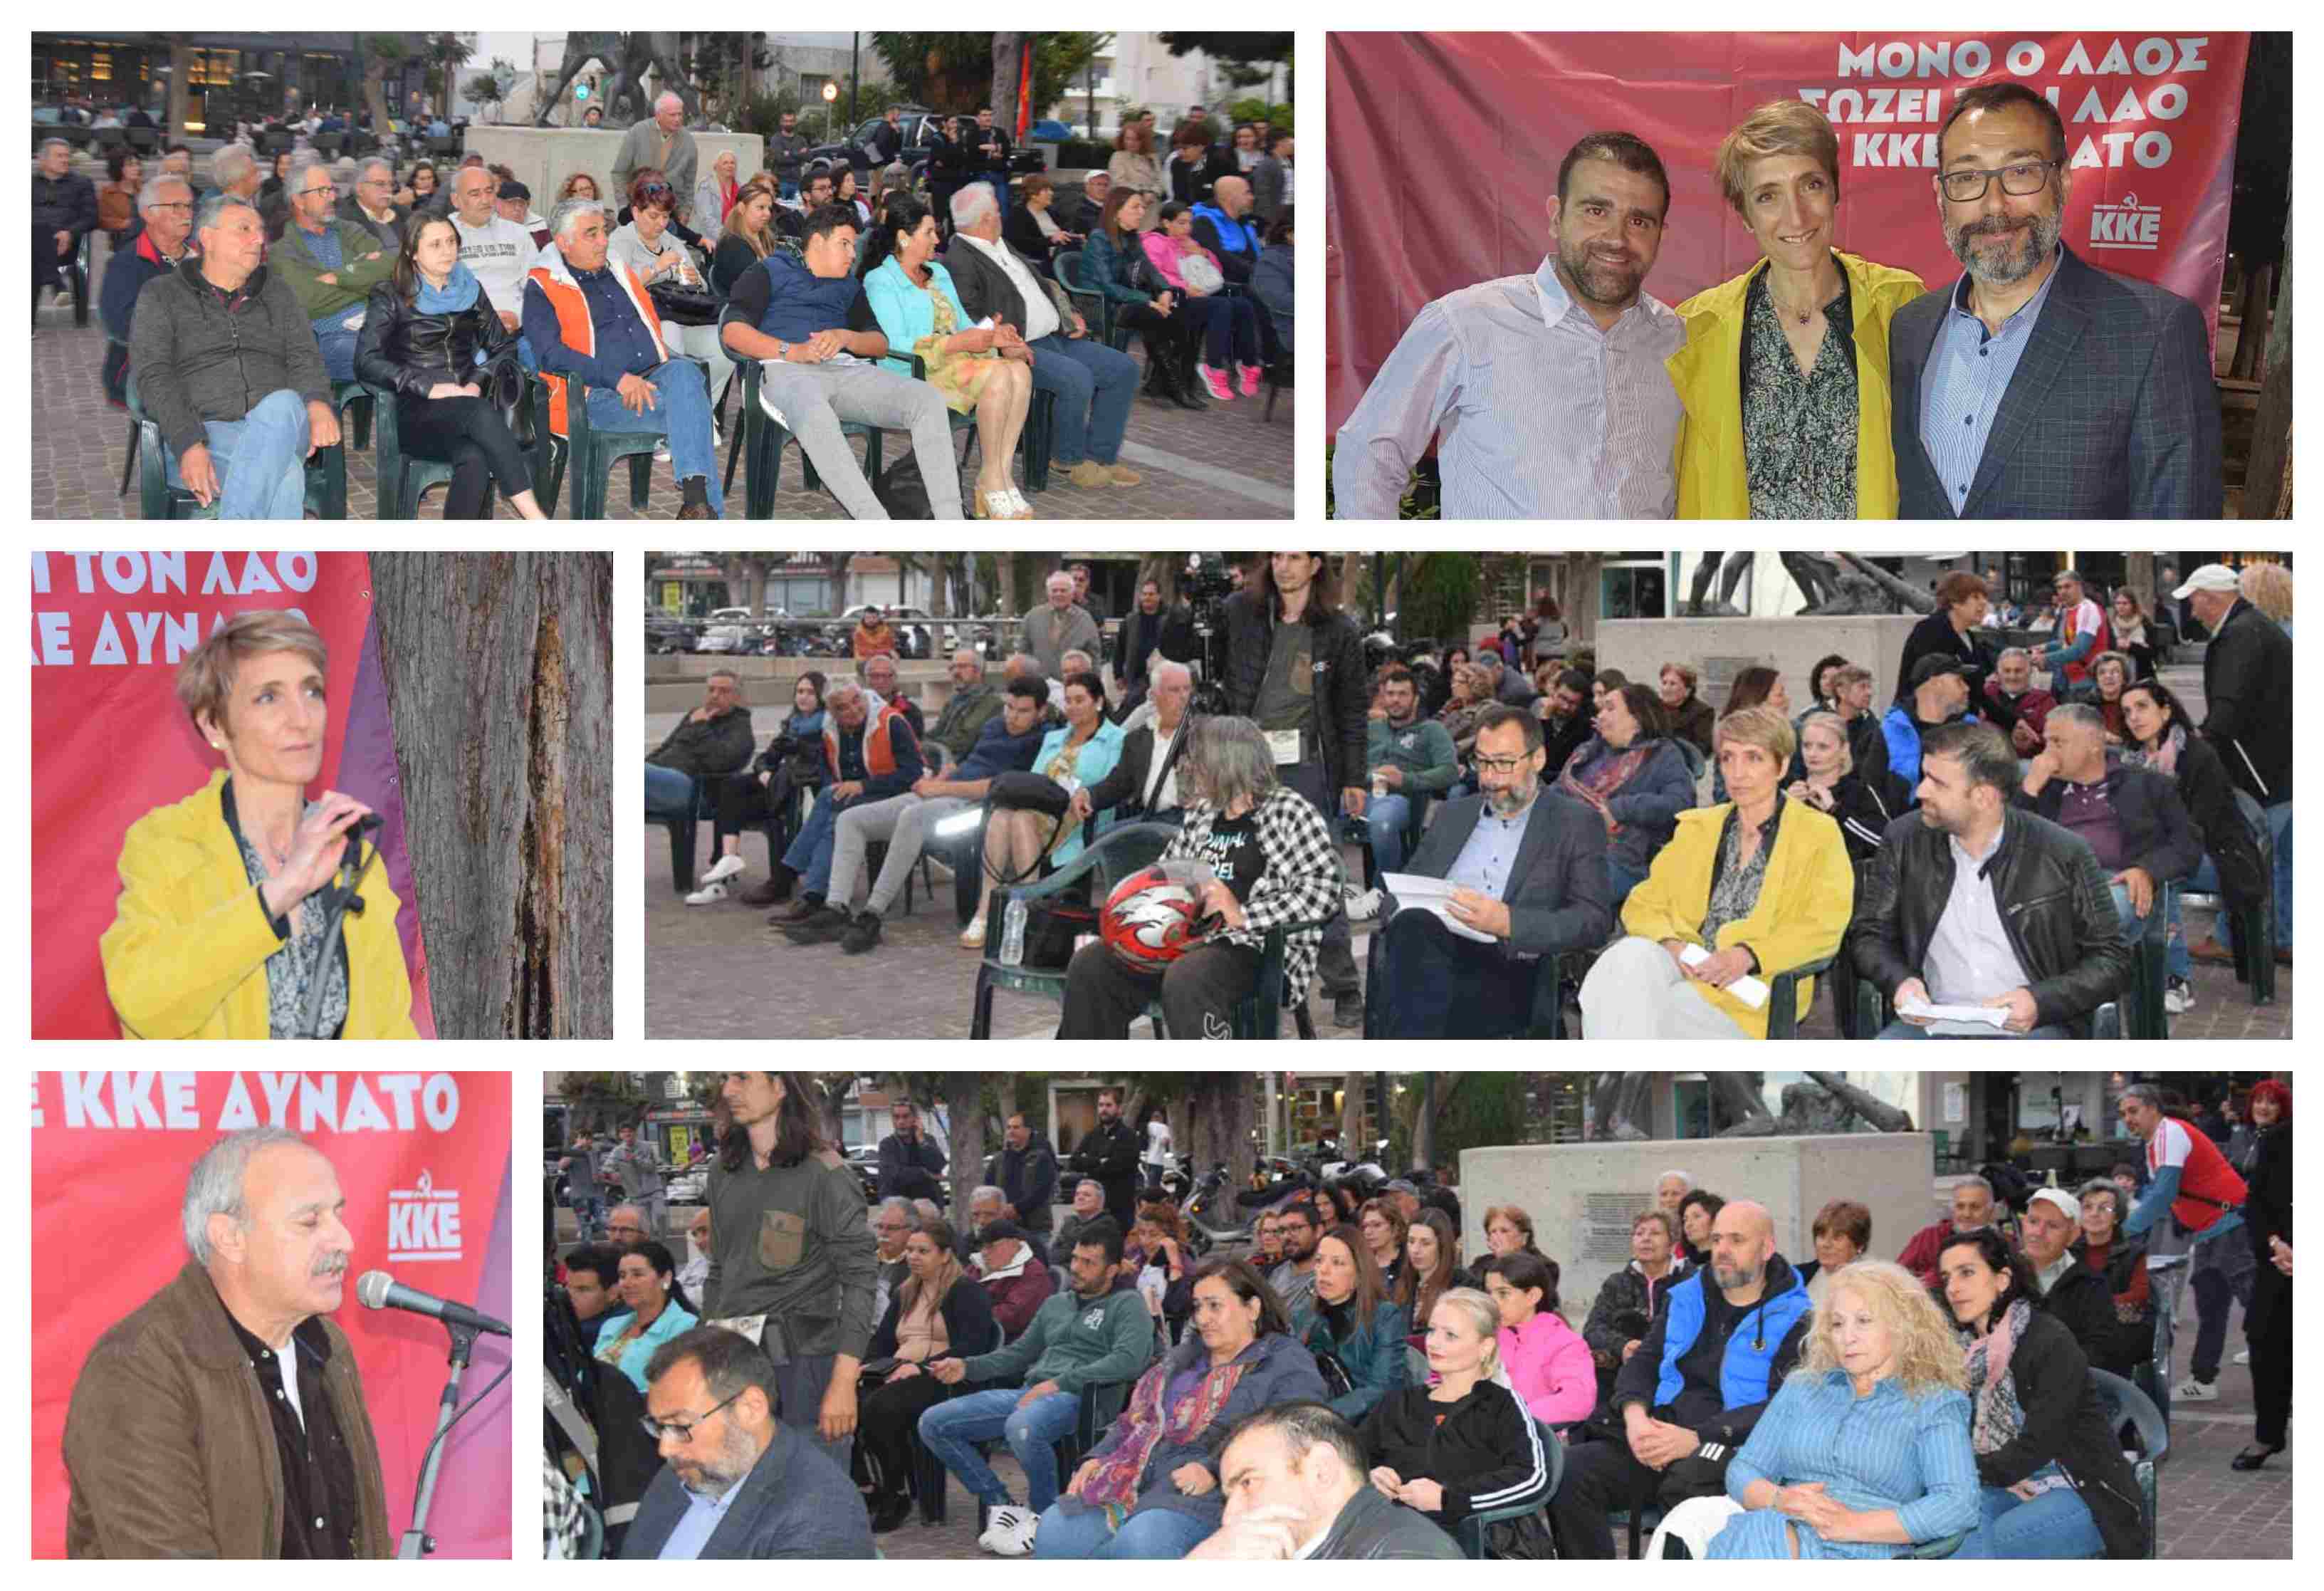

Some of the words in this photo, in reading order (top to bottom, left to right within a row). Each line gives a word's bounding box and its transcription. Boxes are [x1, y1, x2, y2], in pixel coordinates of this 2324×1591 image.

[1838, 41, 1991, 78] ΜΟΝΟ
[2006, 38, 2045, 76] Ο
[2058, 37, 2209, 77] ΛΑΟΣ
[2073, 84, 2189, 123] ΛΑΟ
[2090, 209, 2160, 243] ΚΚΕ
[64, 551, 188, 595] ΤΟΝ
[201, 551, 318, 595] ΛΑΟ
[59, 1071, 200, 1130] ΚΚΕ
[216, 1071, 460, 1132] ΔΥΝΑΤΟ
[388, 1201, 461, 1250] ΚΚΕ
